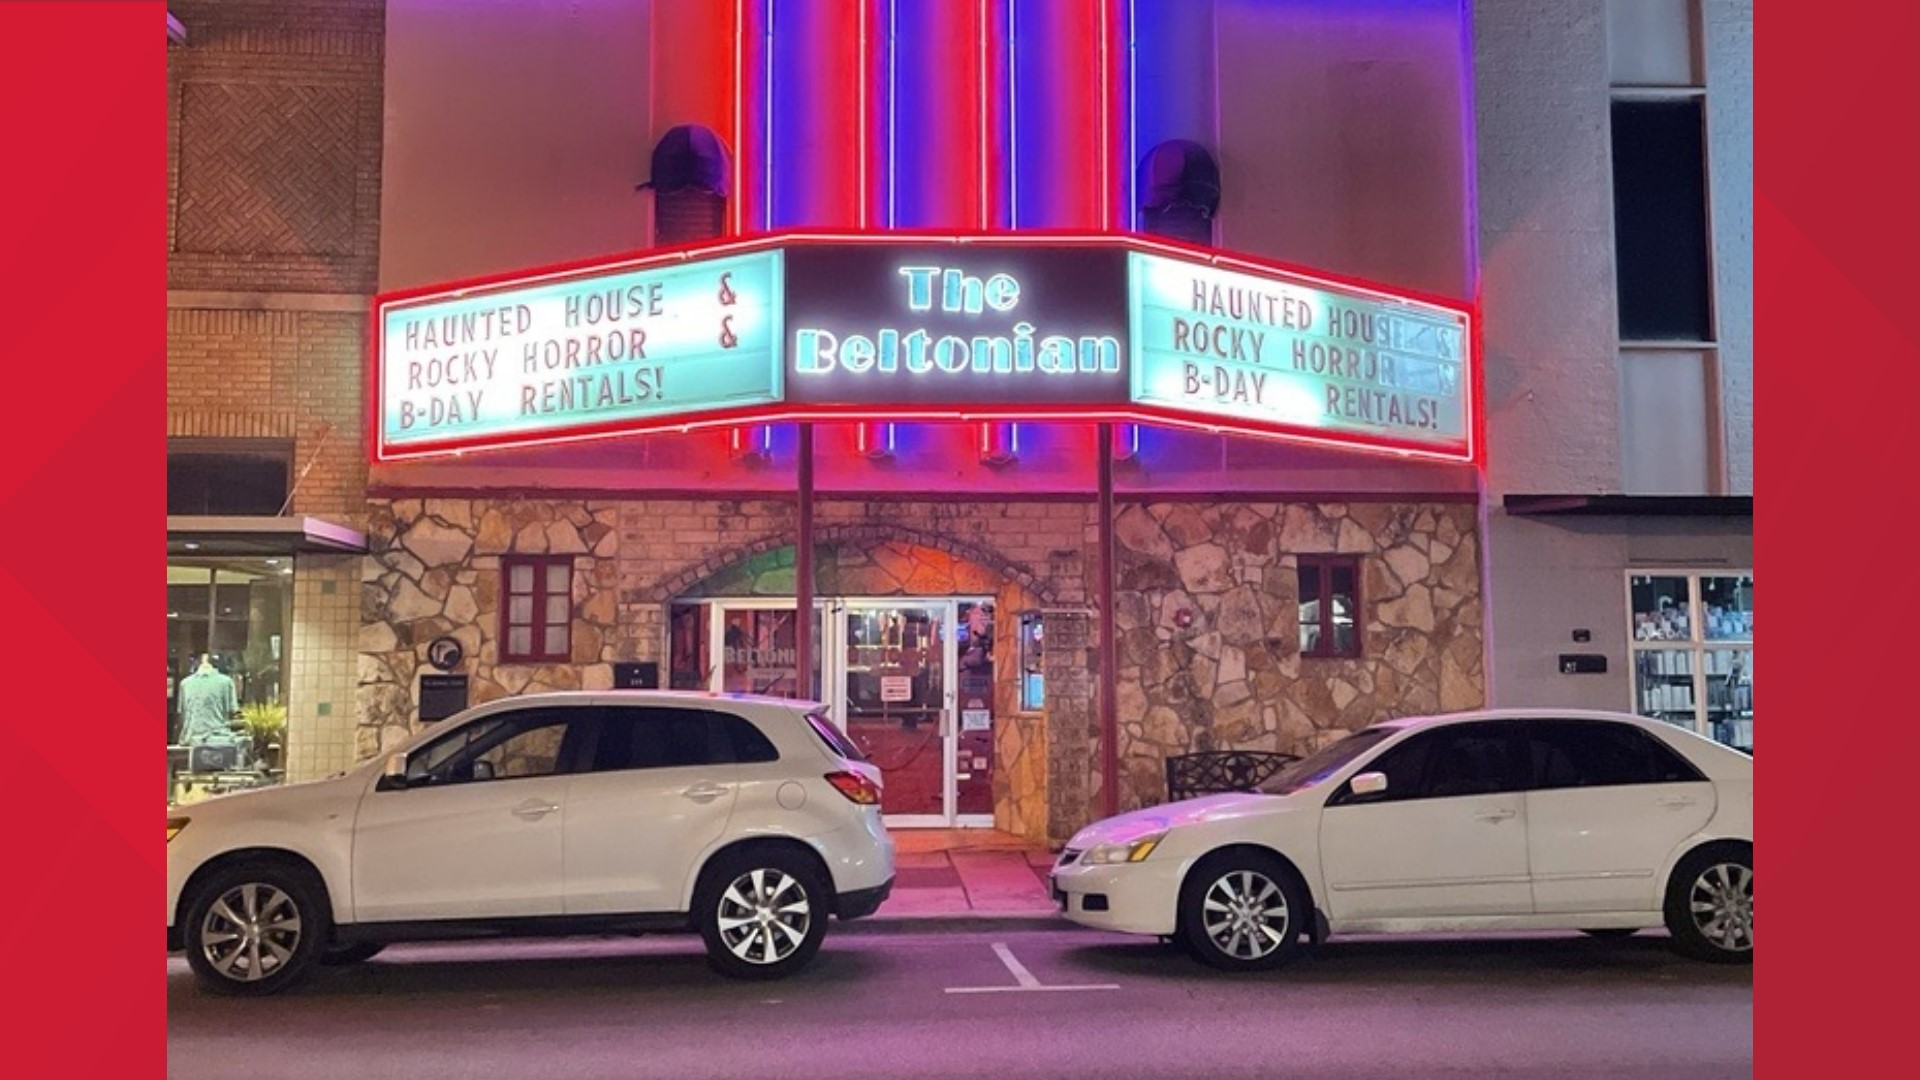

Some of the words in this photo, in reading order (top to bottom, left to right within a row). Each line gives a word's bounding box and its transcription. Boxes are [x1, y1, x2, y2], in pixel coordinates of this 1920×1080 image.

[405, 304, 532, 351] HAUNTED
[564, 282, 664, 328] HOUSE
[717, 271, 738, 306] &
[898, 266, 1021, 314] The
[1191, 278, 1312, 331] HAUNTED
[407, 347, 499, 390] ROCKY
[522, 327, 647, 374] HORROR
[717, 313, 738, 349] &
[795, 321, 1121, 374] Beltonian
[1173, 316, 1265, 364] ROCKY
[1291, 337, 1396, 387] HORROR
[400, 390, 484, 430] B-DAY
[520, 365, 665, 416] RENTALS!
[1182, 360, 1268, 404] B-DAY
[1326, 383, 1439, 430] RENTALS!
